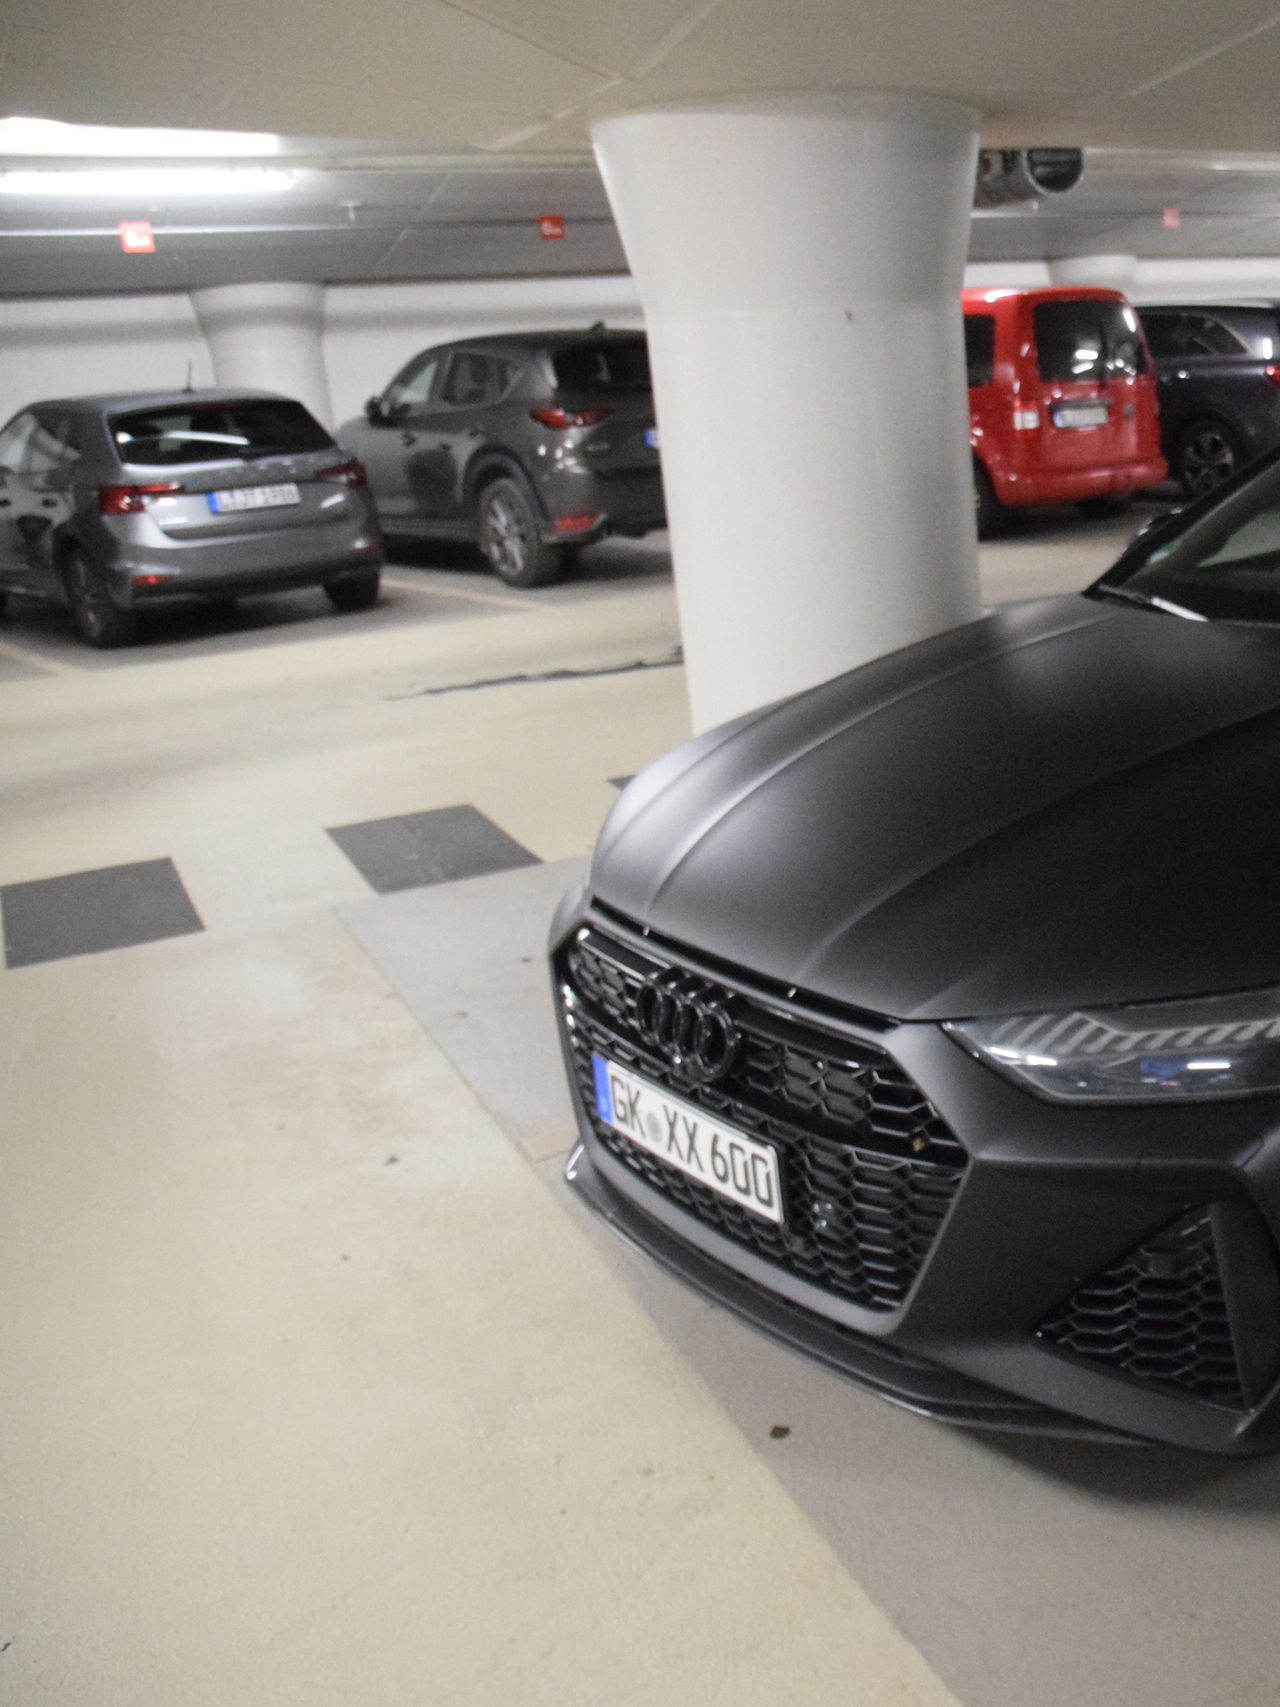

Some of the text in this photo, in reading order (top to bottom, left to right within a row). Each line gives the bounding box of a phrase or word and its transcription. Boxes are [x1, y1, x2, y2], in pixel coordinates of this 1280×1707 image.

[610, 1074, 775, 1209] GK XX 600
